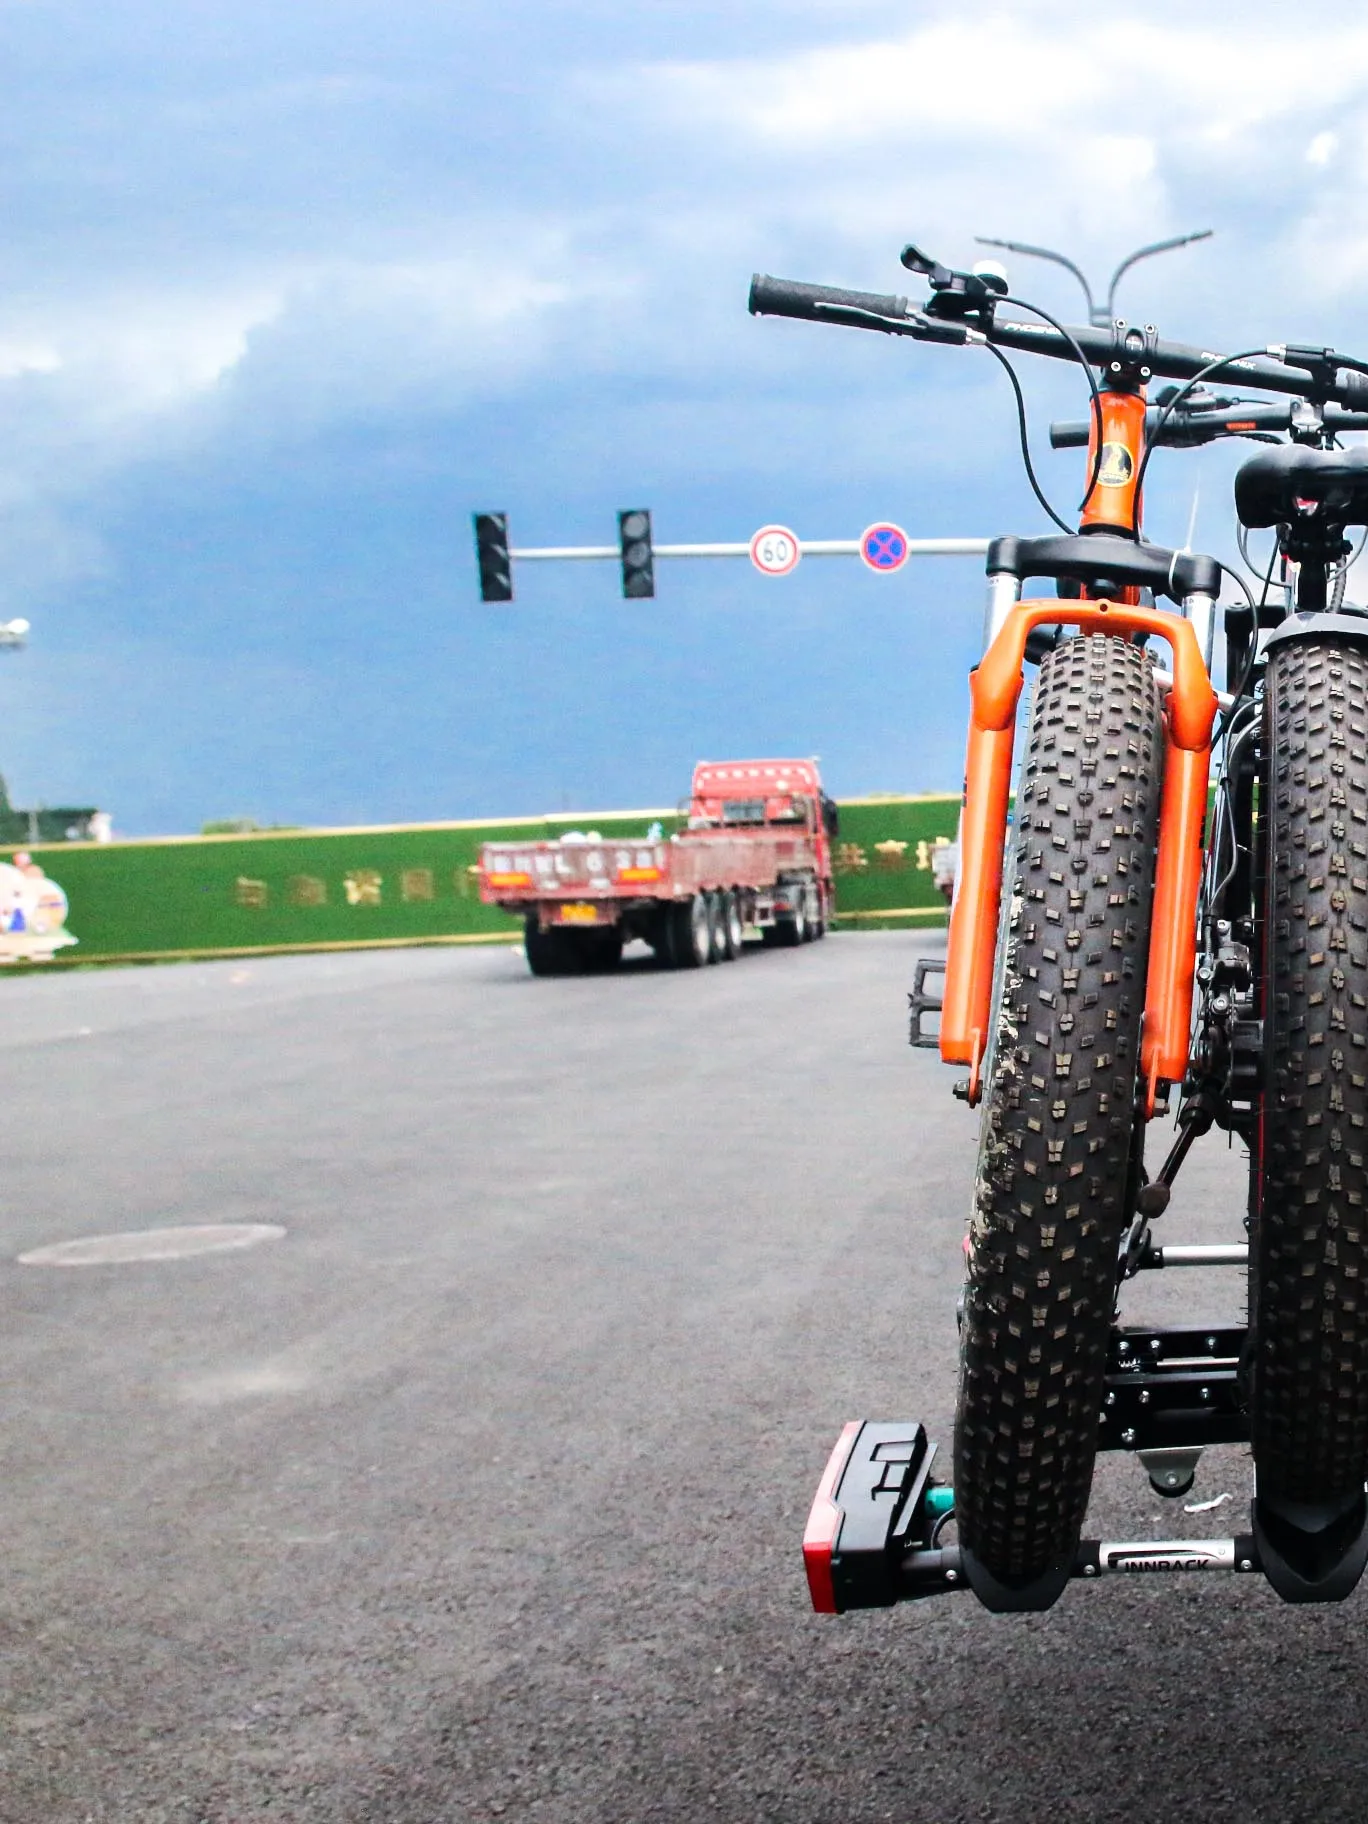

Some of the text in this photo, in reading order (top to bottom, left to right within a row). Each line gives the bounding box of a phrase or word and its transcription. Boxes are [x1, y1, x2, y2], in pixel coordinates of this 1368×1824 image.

[1004, 322, 1062, 336] PHOENI
[764, 540, 787, 562] 60
[1125, 1559, 1209, 1573] INNRACK
